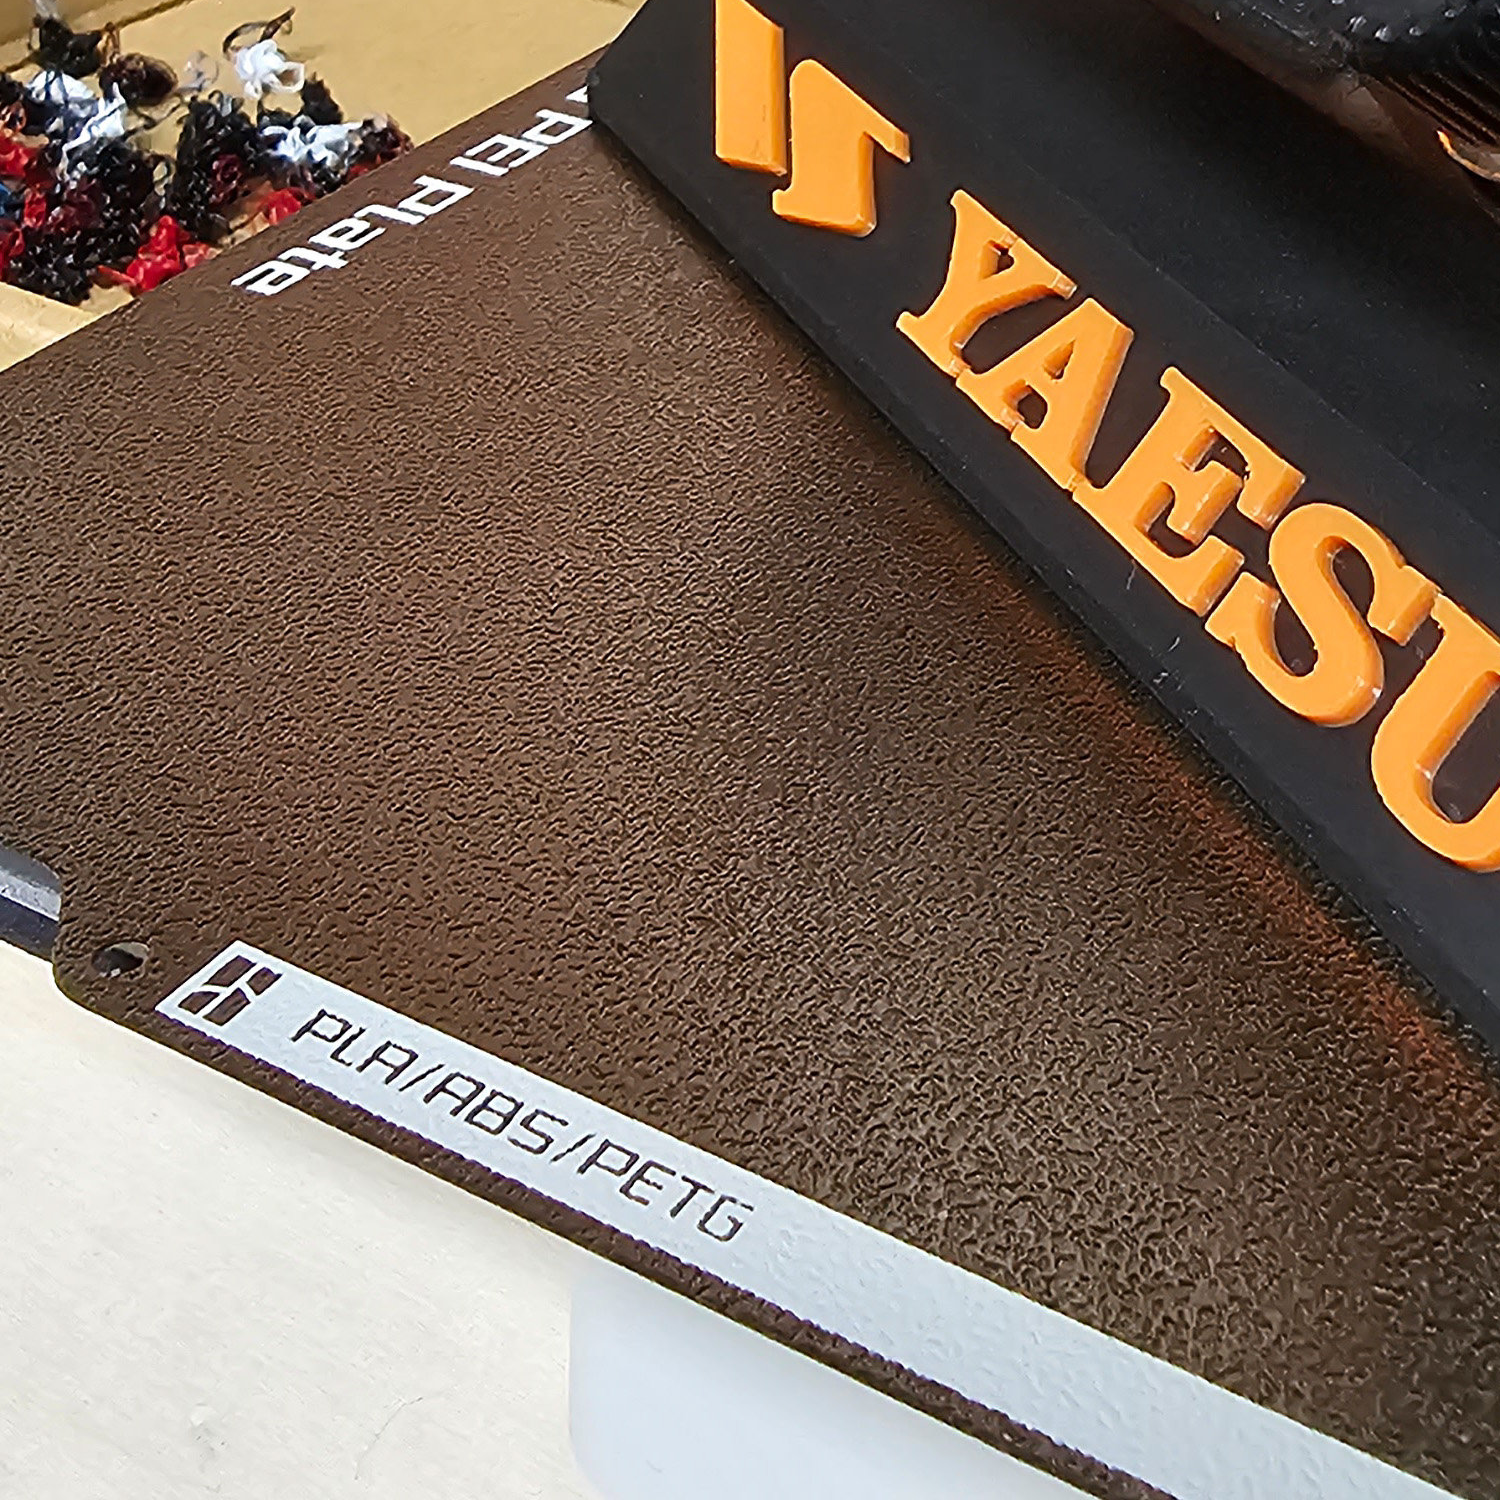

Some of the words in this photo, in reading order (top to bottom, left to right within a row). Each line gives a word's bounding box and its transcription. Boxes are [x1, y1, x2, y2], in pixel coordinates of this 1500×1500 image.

[450, 108, 594, 177] PEI
[230, 174, 476, 297] Plate
[289, 1008, 755, 1242] PLA/ABS/PETG
